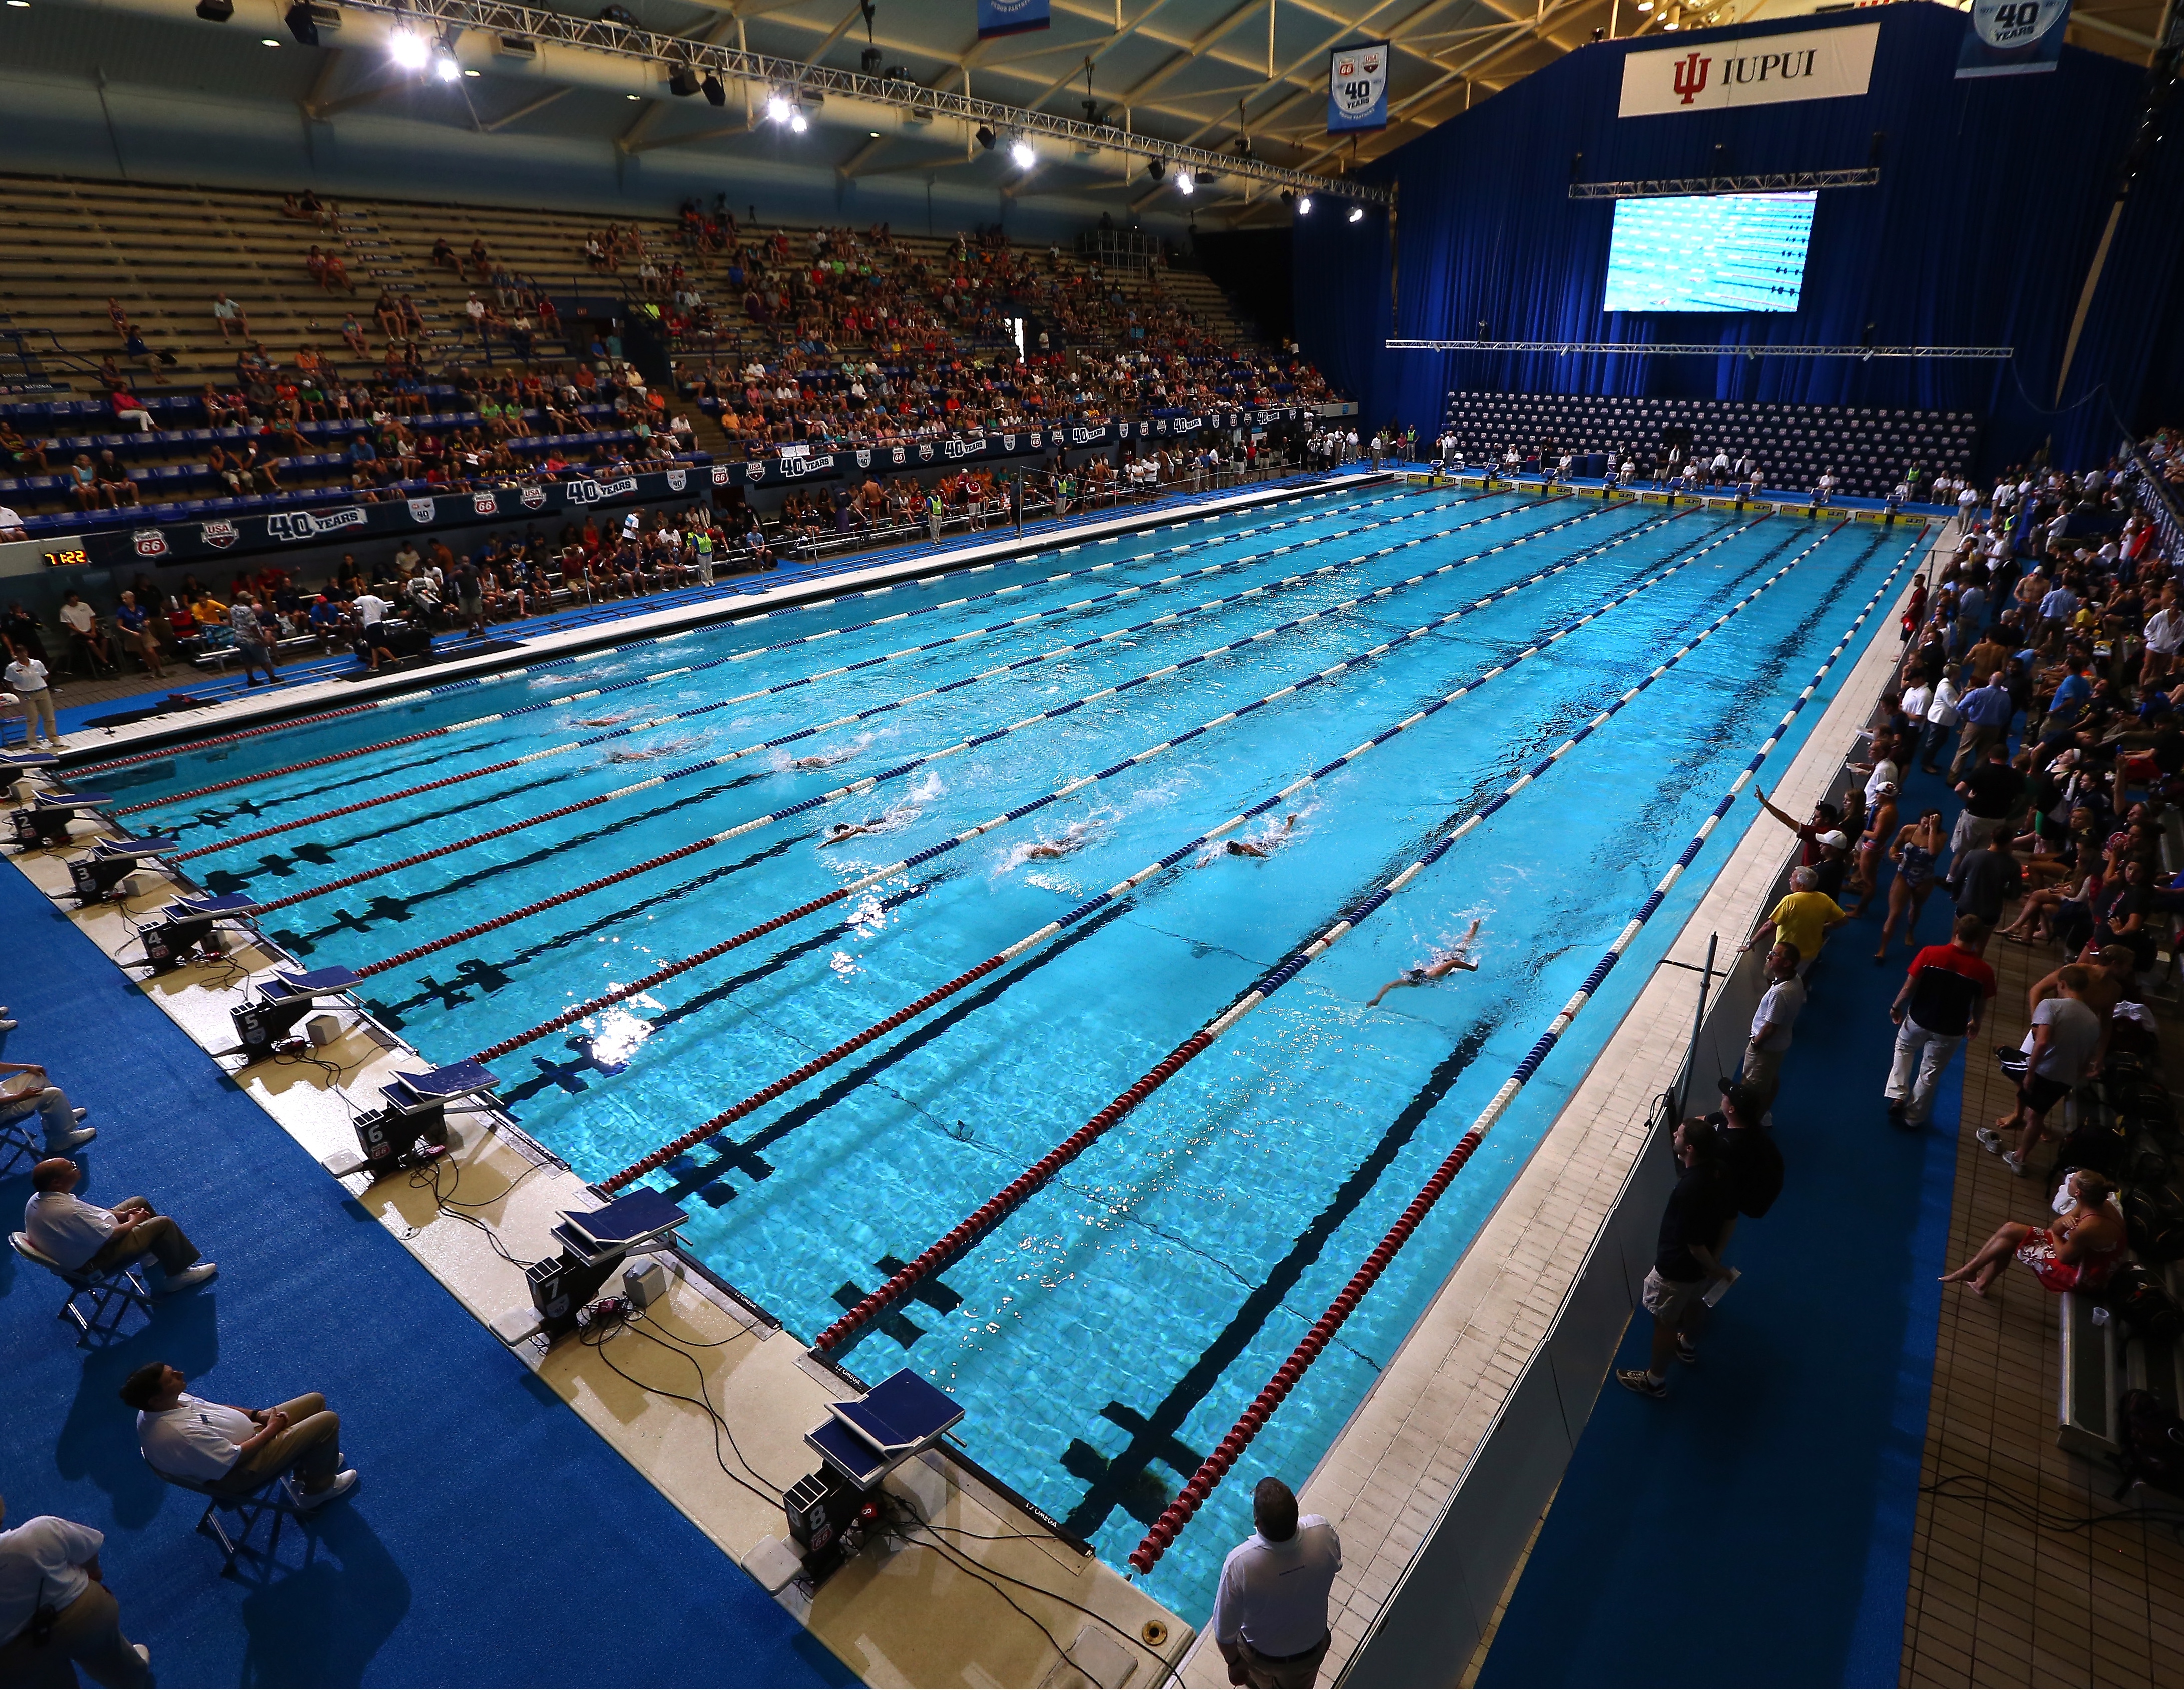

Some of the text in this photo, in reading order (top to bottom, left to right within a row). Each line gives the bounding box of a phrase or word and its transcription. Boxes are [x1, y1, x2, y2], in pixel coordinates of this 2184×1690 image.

[1994, 2, 2040, 28] 40
[1995, 26, 2035, 41] YEARS
[1341, 64, 1352, 74] 66
[1721, 48, 1818, 85] IUPUI
[1345, 80, 1370, 100] 40
[1347, 97, 1369, 109] YEARS
[1173, 418, 1187, 433] 40
[1257, 412, 1268, 425] 40
[1073, 427, 1102, 444] 40 YEARS
[945, 440, 983, 458] 40 YEARS
[781, 457, 829, 477] 40 YEARS
[715, 474, 725, 482] 66
[525, 489, 540, 497] USA
[567, 479, 631, 504] 40 YEARS
[478, 501, 492, 511] 66
[417, 510, 429, 518] 40
[208, 524, 229, 533] USA
[268, 511, 358, 540] 40 YEARS
[141, 541, 160, 552] 66
[18, 816, 30, 827] 2
[77, 867, 90, 880] 3
[148, 932, 162, 944] 4
[245, 1014, 258, 1030] 5
[368, 1124, 383, 1142] 6
[375, 1147, 386, 1156] 66
[545, 1277, 559, 1299] 7
[842, 1369, 860, 1385] OMEGA
[787, 1504, 801, 1527] 8
[810, 1505, 826, 1530] 8
[1034, 1509, 1057, 1528] OMEGA
[815, 1531, 828, 1545] 66
